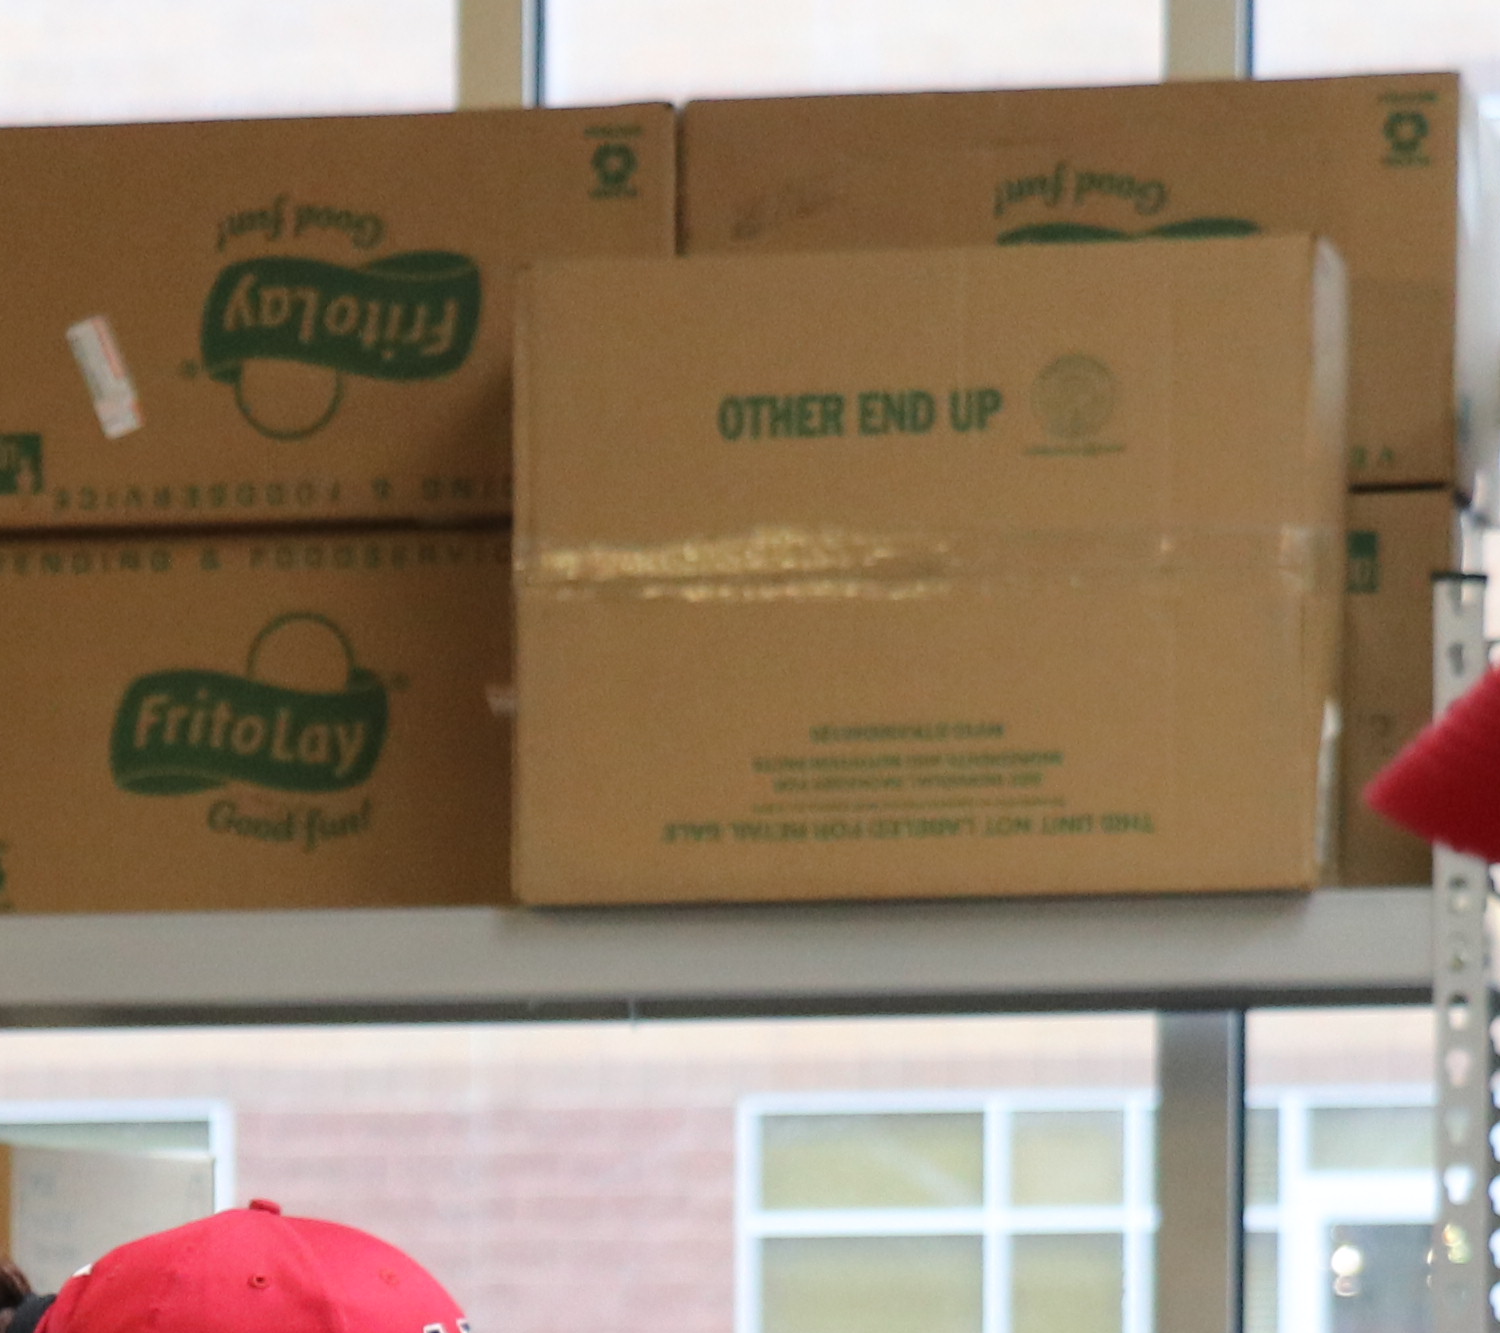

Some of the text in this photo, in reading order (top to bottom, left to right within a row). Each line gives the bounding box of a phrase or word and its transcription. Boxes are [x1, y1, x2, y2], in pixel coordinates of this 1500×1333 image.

[715, 387, 1005, 442] OTHER END UP
